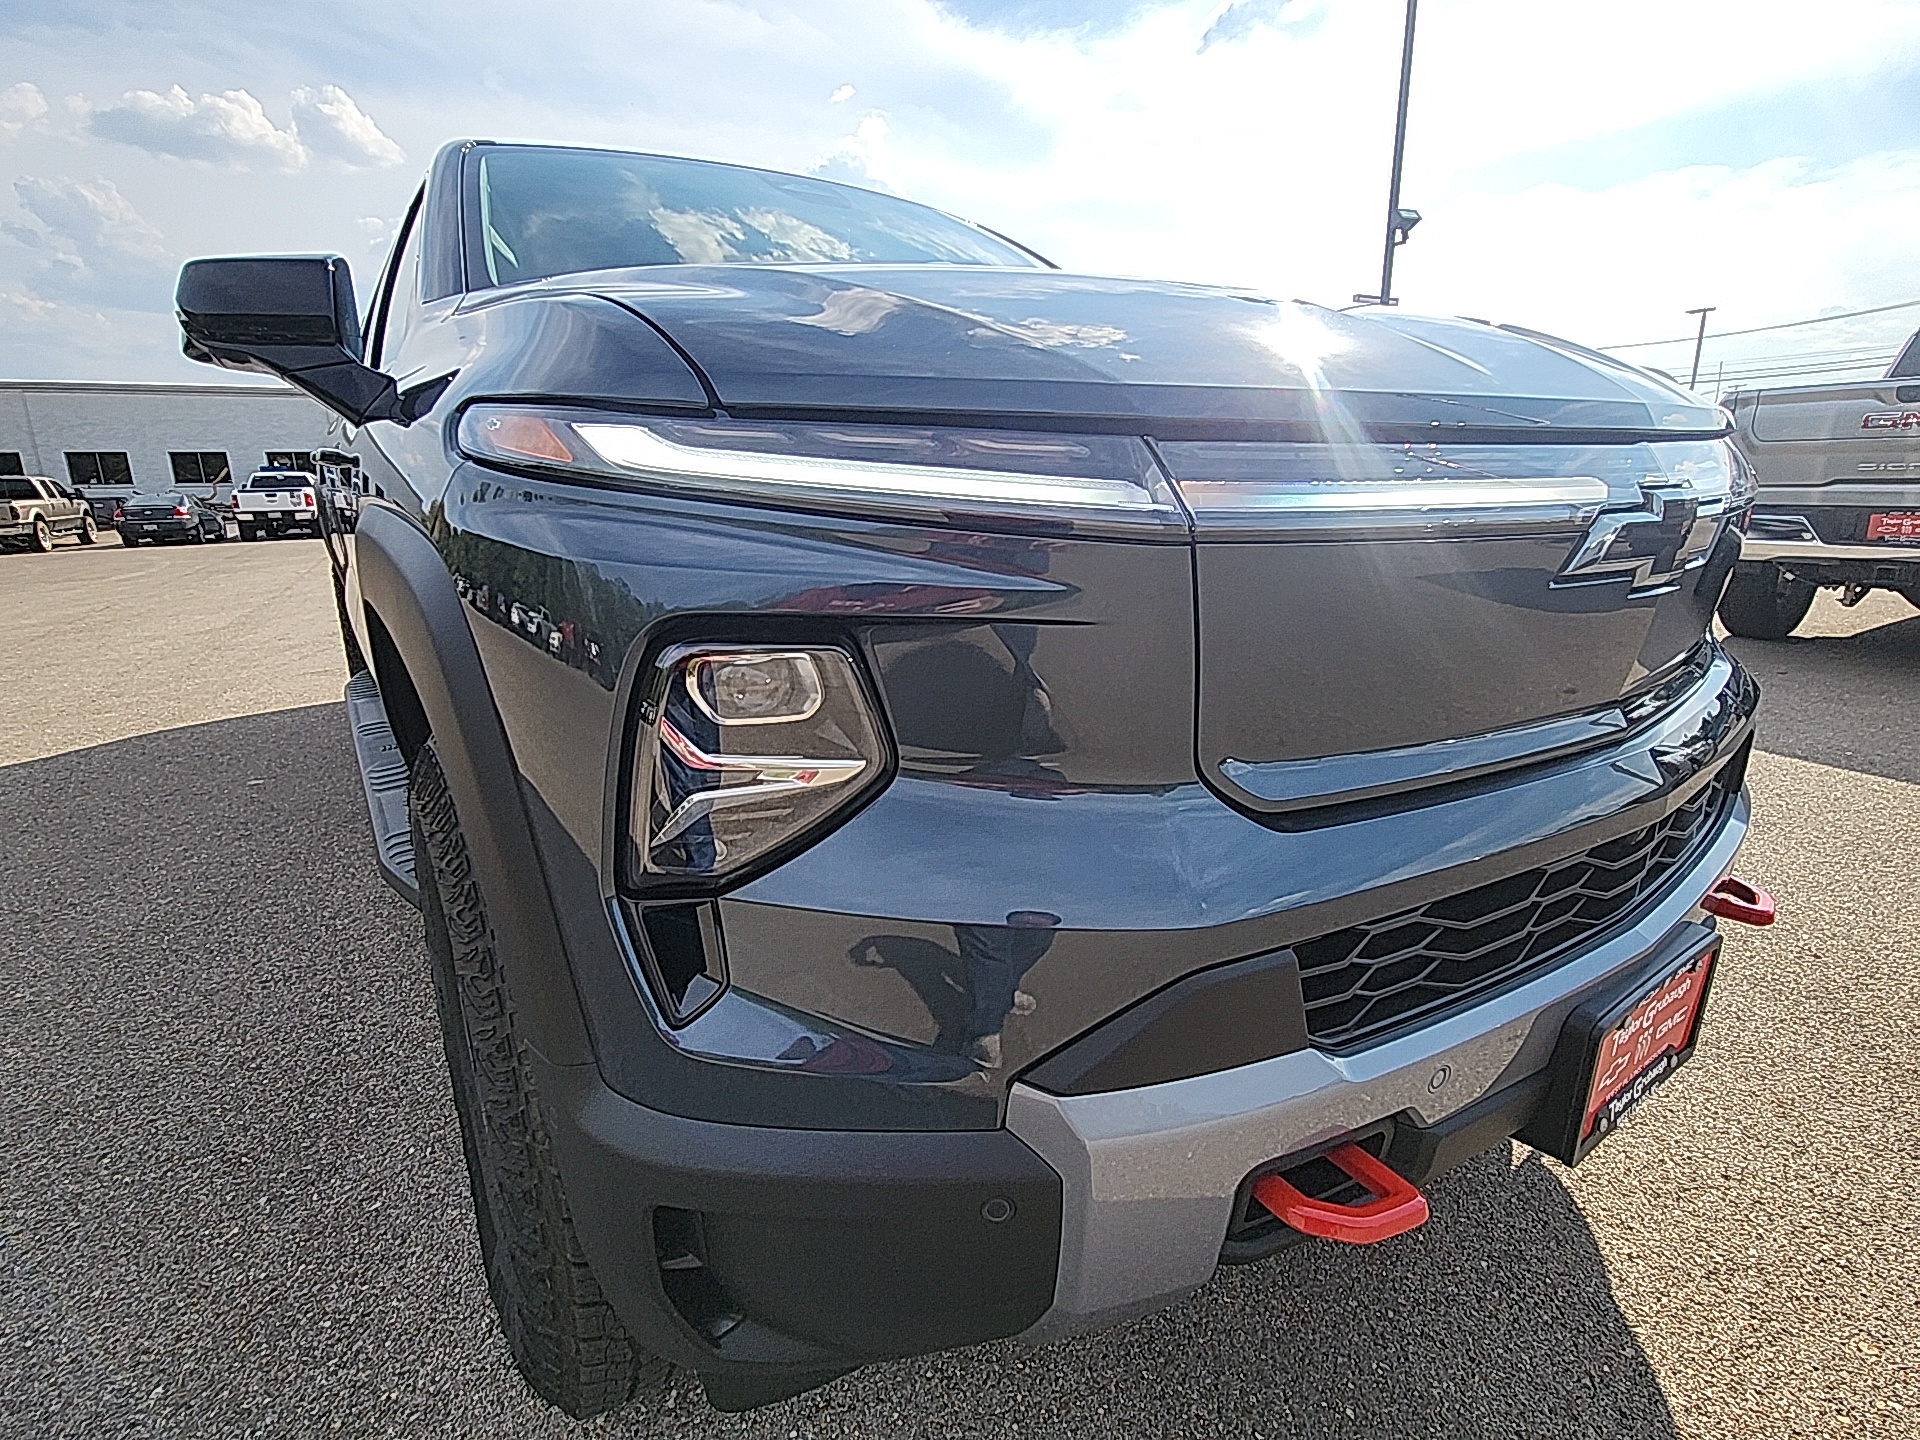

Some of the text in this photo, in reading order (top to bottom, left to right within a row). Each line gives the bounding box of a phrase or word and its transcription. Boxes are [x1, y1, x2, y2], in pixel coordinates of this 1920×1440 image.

[1611, 977, 1692, 1057] Taylor Grubaugh
[1655, 1005, 1689, 1040] GMC
[1608, 1056, 1668, 1122] Taylor Grubaugh
